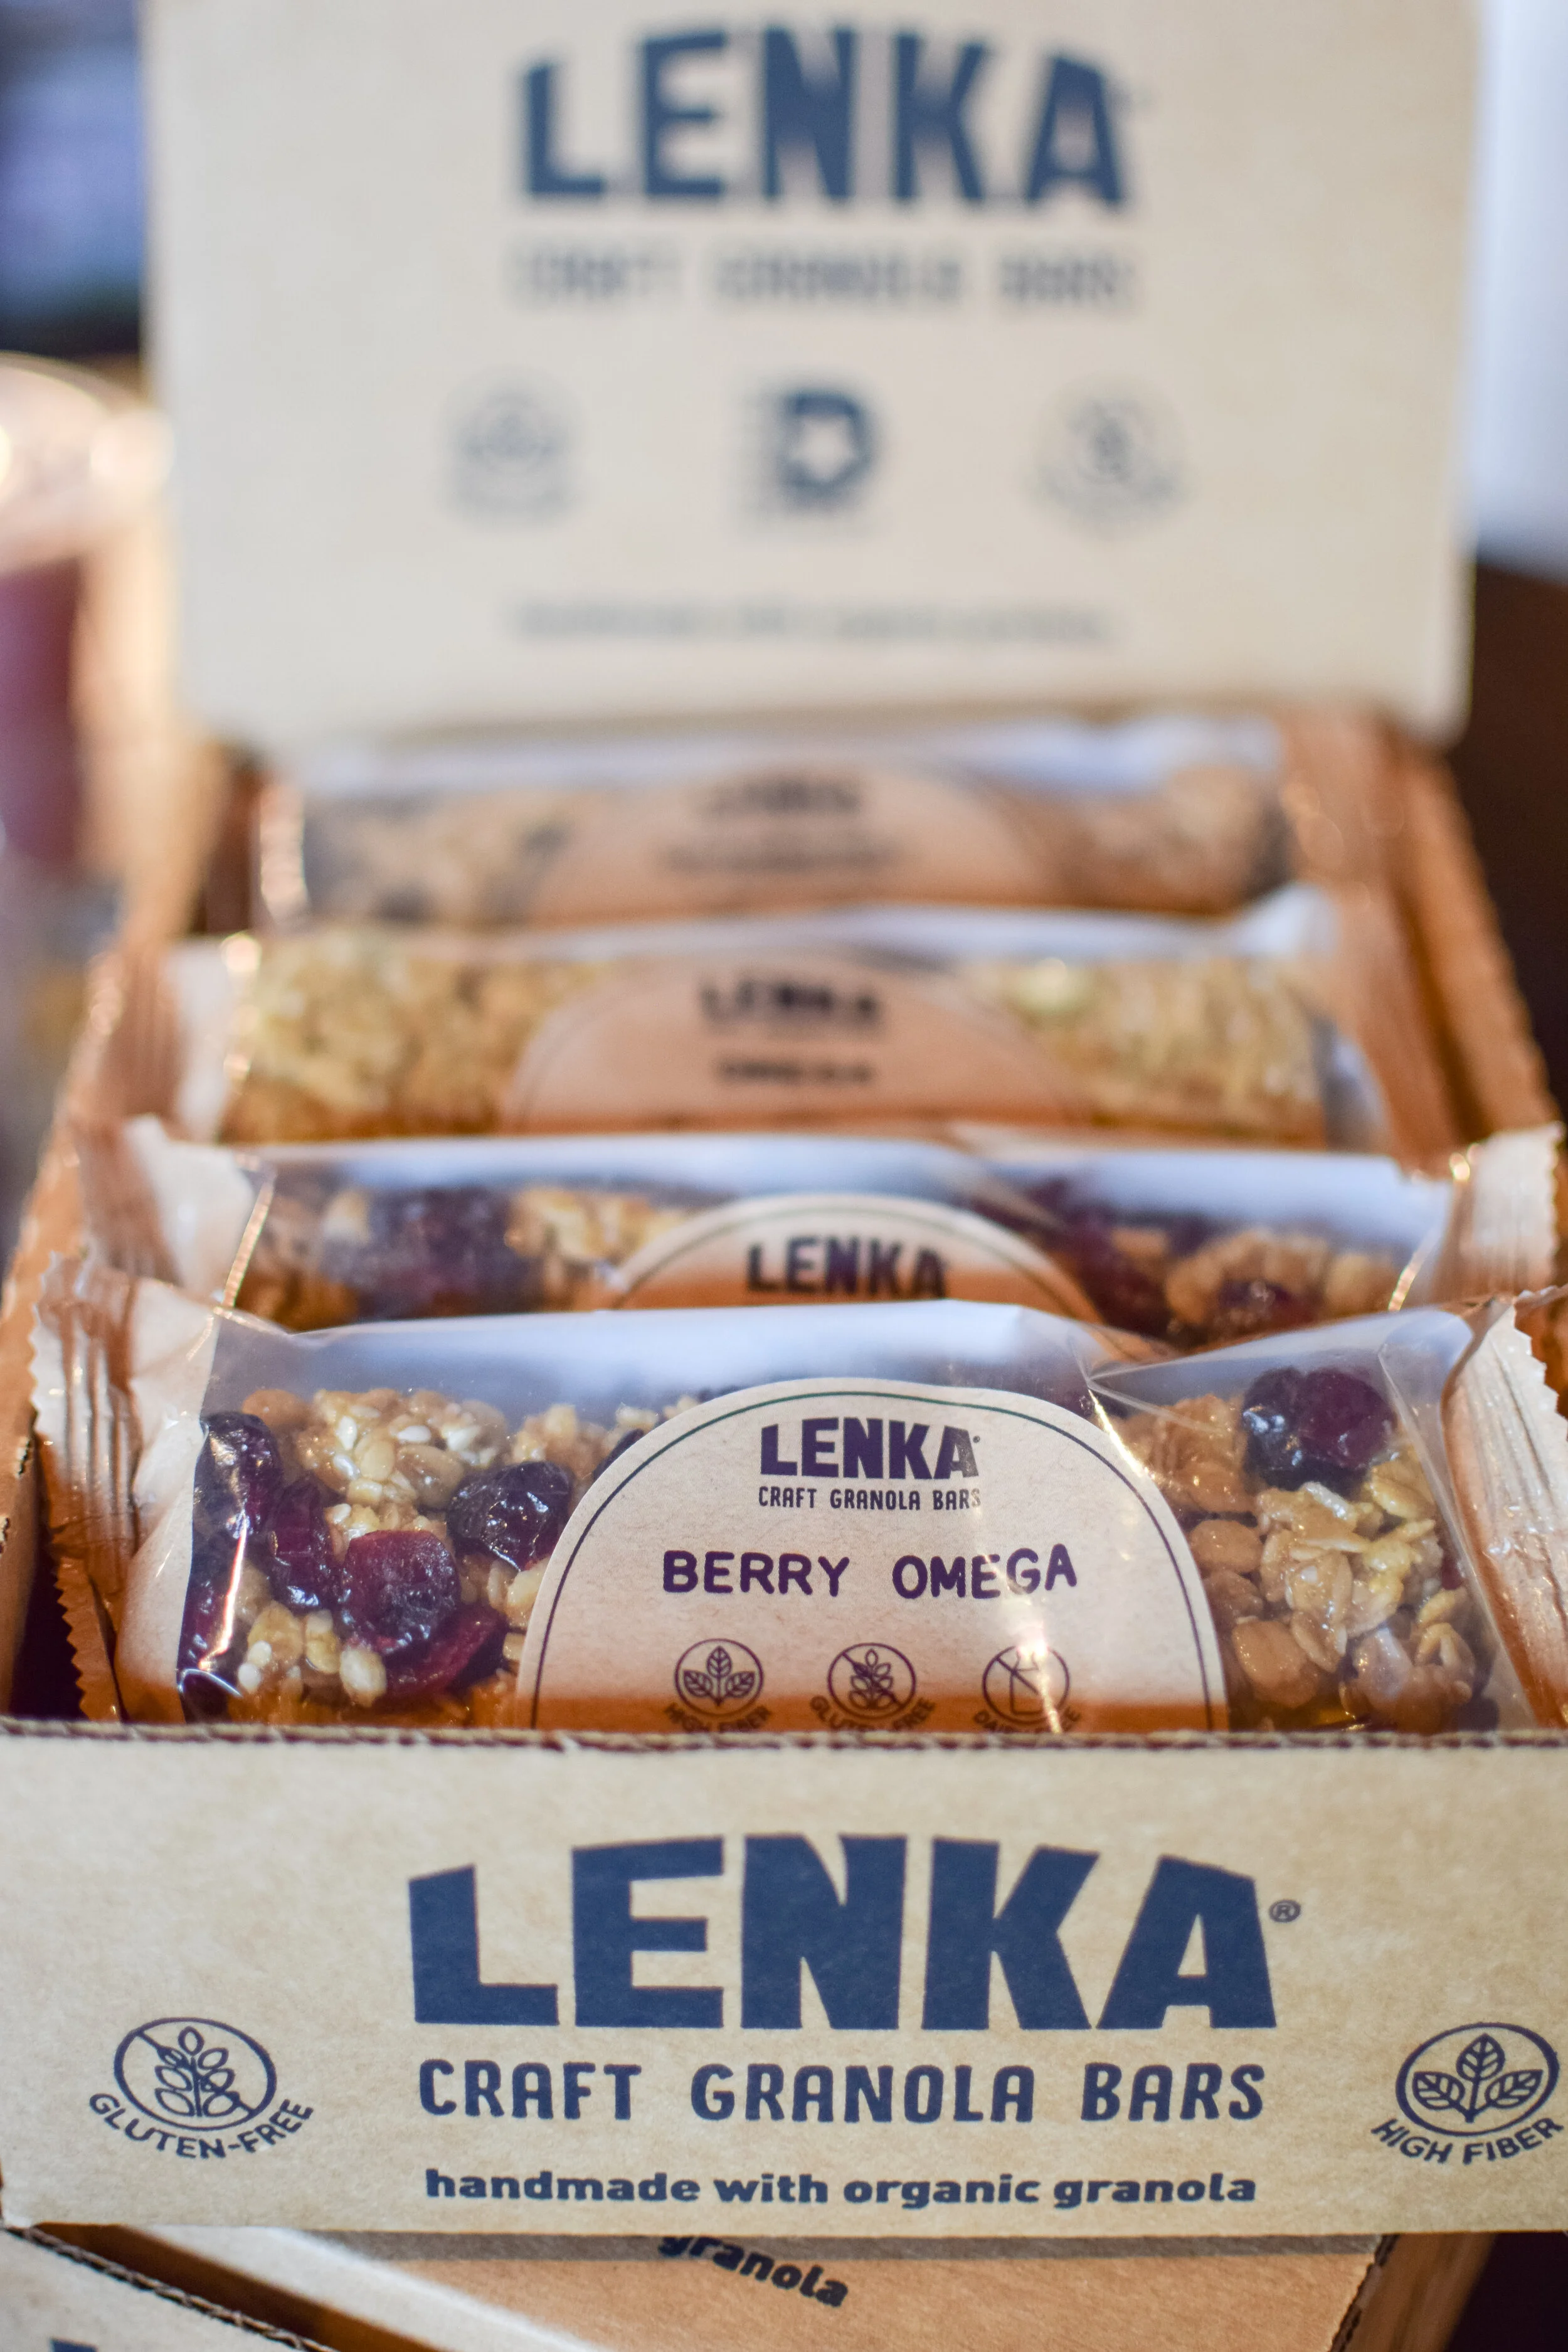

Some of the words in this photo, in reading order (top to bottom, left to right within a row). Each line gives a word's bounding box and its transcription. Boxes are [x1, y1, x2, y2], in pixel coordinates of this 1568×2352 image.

[522, 26, 1125, 204] LENKA
[748, 1233, 948, 1300] LENKA
[759, 1486, 817, 1508] CRAFT
[830, 1488, 920, 1510] GRANOLA
[933, 1489, 981, 1510] BARS
[662, 1550, 850, 1597] BERRY
[891, 1543, 1077, 1599] OMEGA
[418, 2058, 642, 2120] CRAFT
[691, 2063, 1035, 2123] GRANOLA
[1081, 2062, 1265, 2121] BARS
[89, 2093, 314, 2159] GLUTEN-FREE
[1370, 2118, 1454, 2164] HIGH
[1462, 2117, 1564, 2166] FIBER
[425, 2168, 701, 2203] handmade
[714, 2173, 829, 2203] with
[844, 2173, 1041, 2209] organic
[1054, 2173, 1256, 2209] granola
